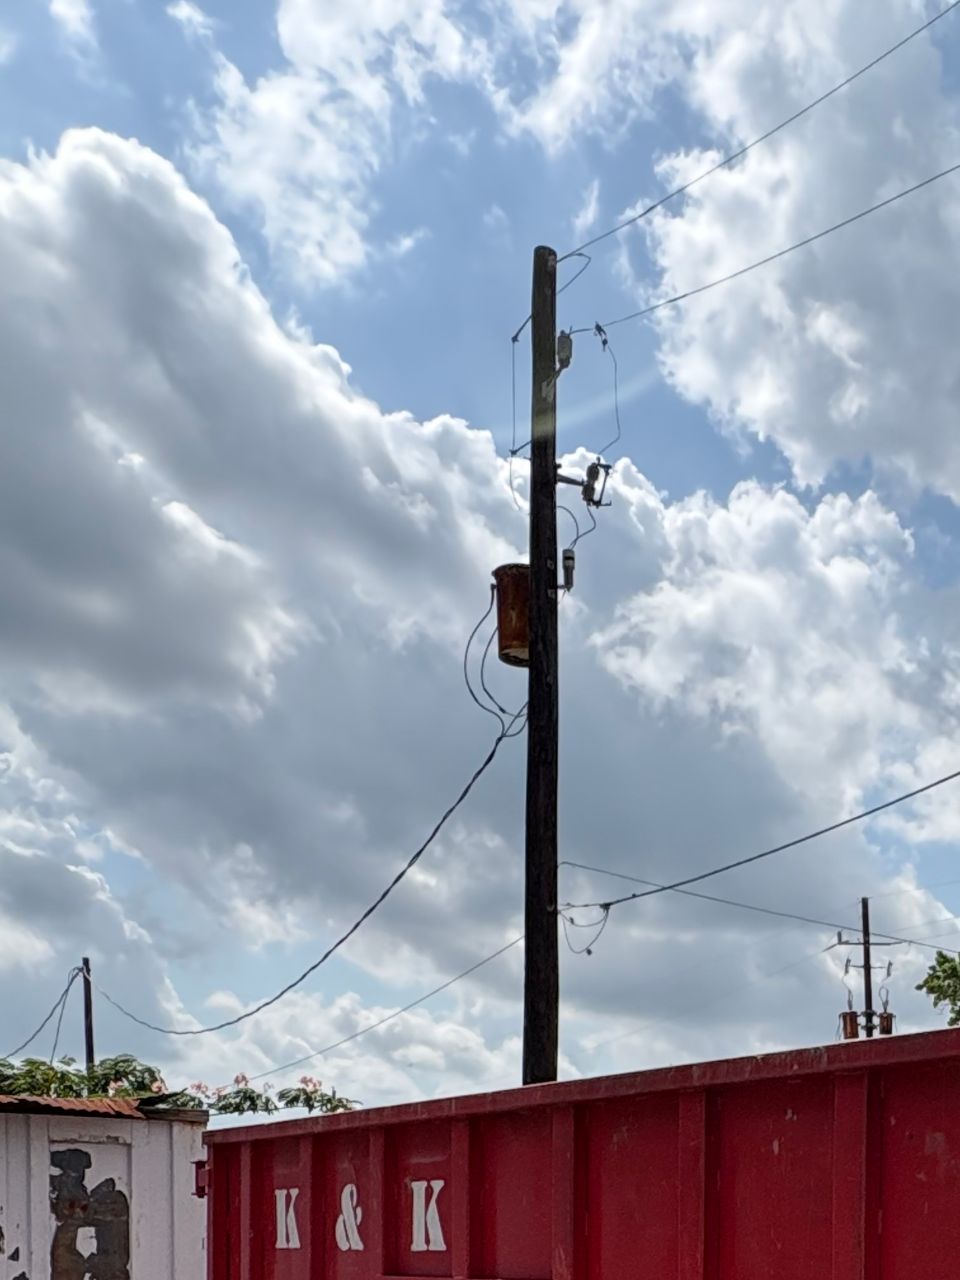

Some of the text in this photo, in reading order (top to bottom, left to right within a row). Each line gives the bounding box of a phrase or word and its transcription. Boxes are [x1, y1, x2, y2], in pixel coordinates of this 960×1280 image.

[275, 1180, 446, 1252] K & K
